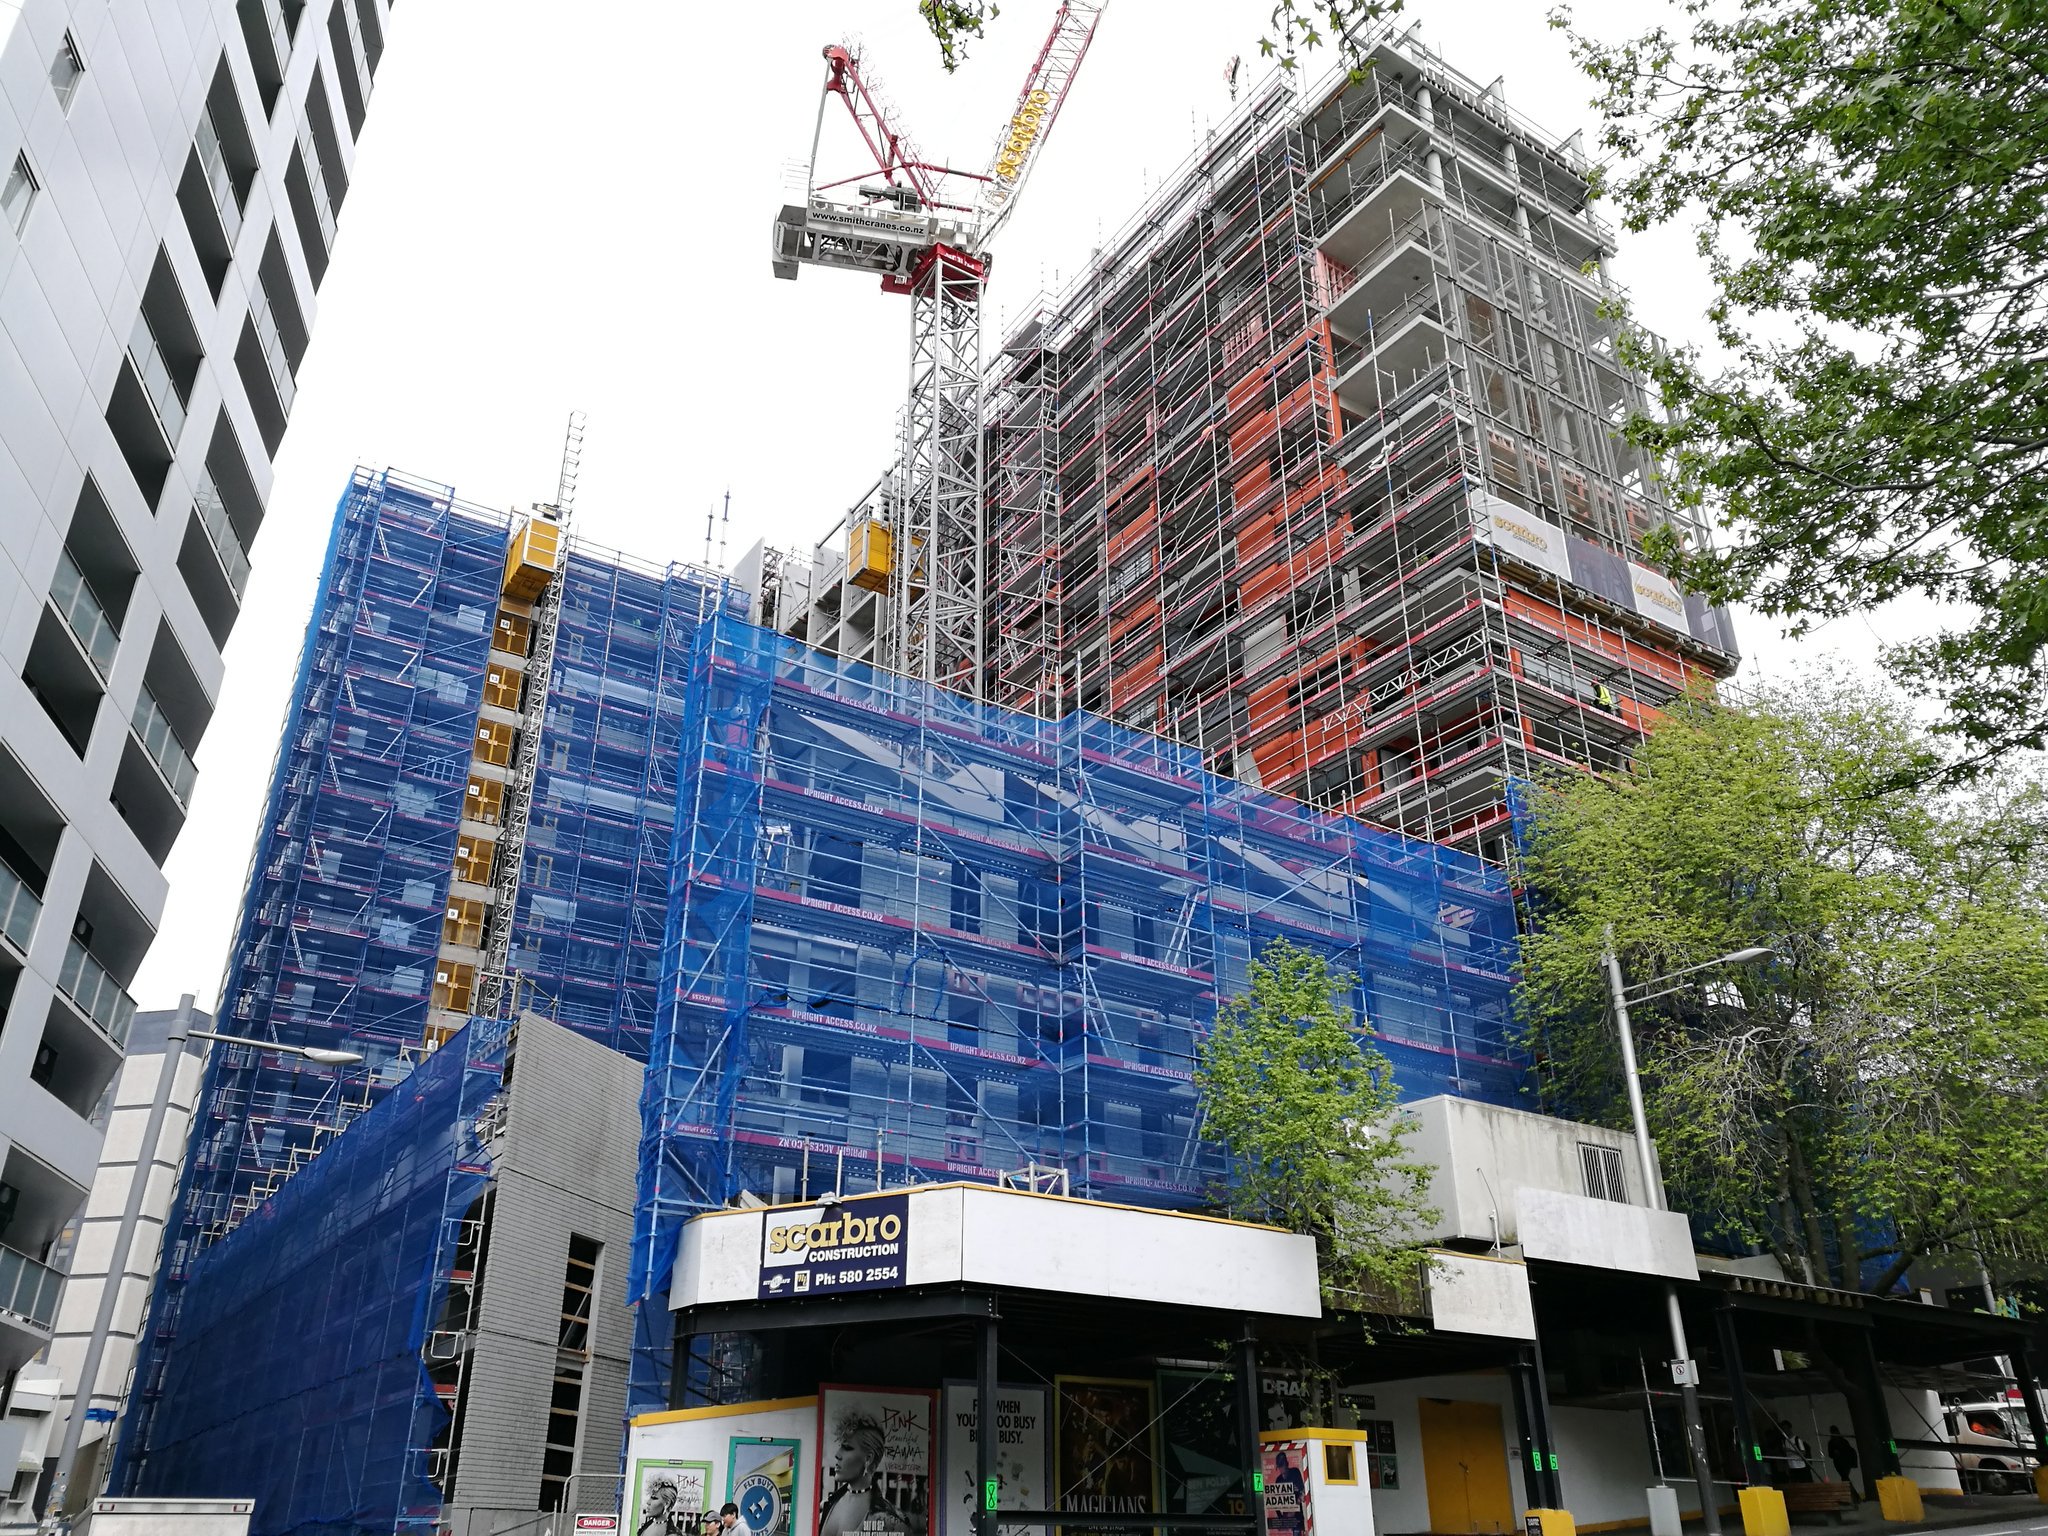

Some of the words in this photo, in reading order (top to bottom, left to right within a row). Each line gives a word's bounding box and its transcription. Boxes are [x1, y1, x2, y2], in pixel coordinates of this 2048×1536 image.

[812, 212, 924, 234] www.smithcranes.co.nz
[811, 687, 839, 701] UPRIGHT
[841, 694, 888, 716] ACCESS.CO.NZ
[804, 788, 833, 802] UPRIGHT
[835, 795, 884, 815] ACCESS.CO.NZ
[801, 896, 832, 911] UPRIGHT
[833, 903, 884, 922] ACCESS.CO.NZ
[1121, 952, 1147, 964] UPRIGHT
[1148, 957, 1188, 975] ACCESS.CO.NZ
[792, 1009, 823, 1023] UPRIGHT
[825, 1016, 877, 1033] ACCESS.CO.NZ
[950, 1042, 978, 1055] UPRIGHT
[979, 1047, 1027, 1065] ACCESS.CO.NZ
[1123, 1060, 1149, 1073] UPRIGHT
[1150, 1066, 1193, 1081] ACCESS.CO.NZ
[778, 1138, 834, 1154] ACCES.CO.NZ
[947, 1162, 976, 1175] UPRIGHT
[770, 1212, 901, 1254] scarbro
[809, 1243, 899, 1263] CONSTRUCTION
[815, 1273, 836, 1286] Ph:
[839, 1270, 863, 1284] 580
[866, 1266, 899, 1281] 2554
[1013, 1416, 1036, 1430] BUSY
[999, 1431, 1024, 1444] BUSY.
[743, 1479, 756, 1490] FLY
[757, 1477, 774, 1492] BUYS
[1265, 1484, 1293, 1494] BRYAN
[987, 1484, 995, 1508] 8
[1066, 1494, 1146, 1514] MAGICIANS
[1265, 1496, 1295, 1506] ADAMS
[583, 1519, 611, 1527] DANGER
